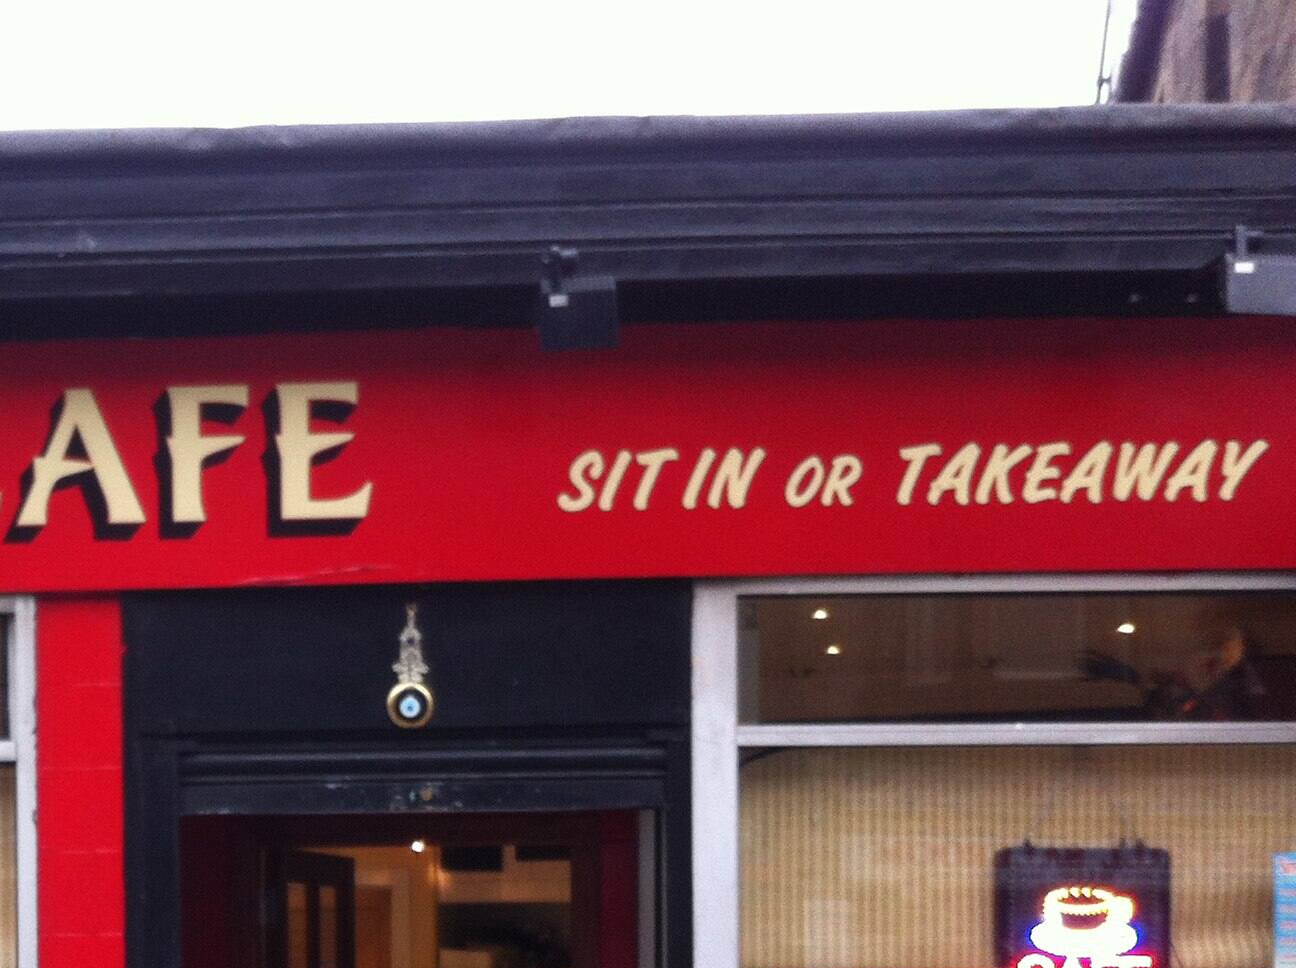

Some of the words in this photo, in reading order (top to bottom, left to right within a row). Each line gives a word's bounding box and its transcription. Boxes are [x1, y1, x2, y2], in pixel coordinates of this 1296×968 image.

[557, 448, 680, 513] SIT
[681, 446, 767, 512] IN
[784, 454, 864, 509] OR
[895, 438, 1270, 507] TAKEAWAY
